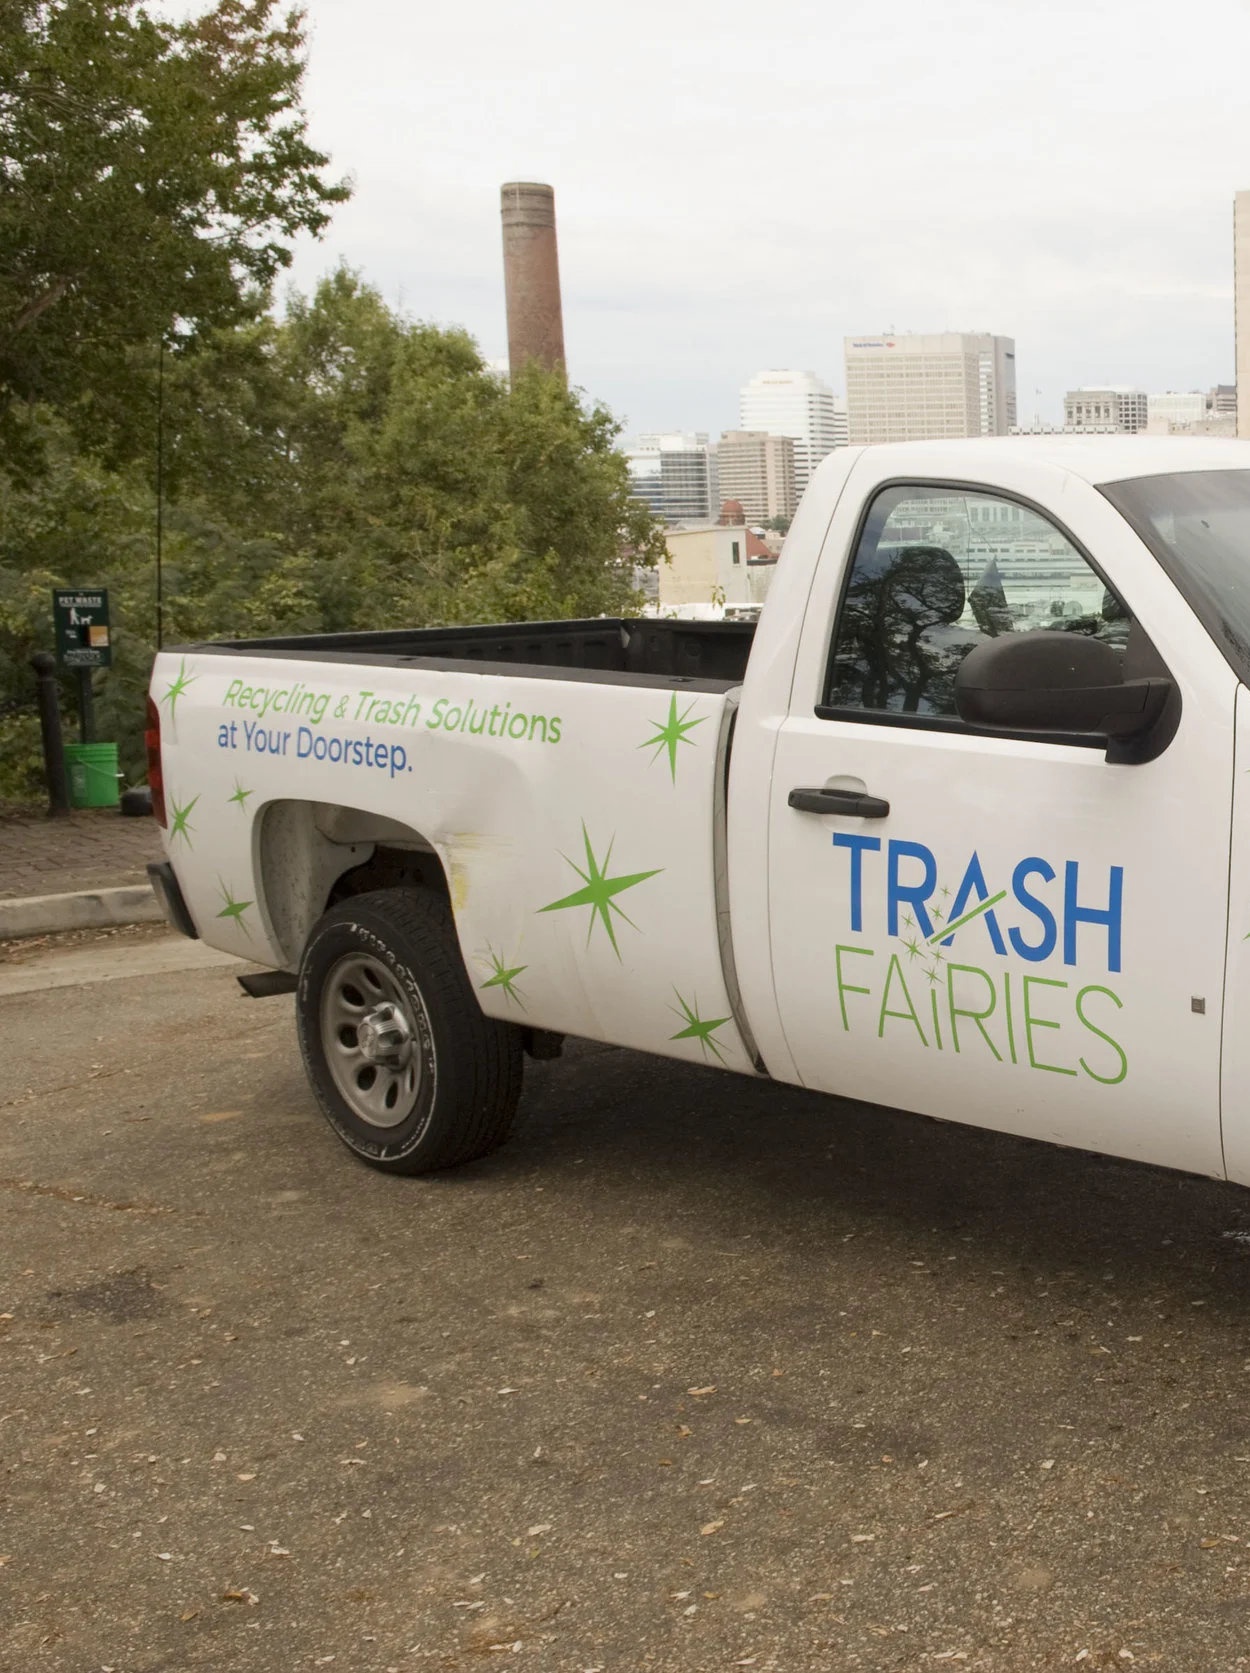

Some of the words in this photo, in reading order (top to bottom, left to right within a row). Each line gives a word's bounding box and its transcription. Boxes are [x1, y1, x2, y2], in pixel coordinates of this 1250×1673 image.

[222, 679, 330, 725] Recycling
[334, 695, 347, 719] &
[354, 690, 421, 727] Trash
[426, 699, 562, 745] Solutions
[217, 722, 237, 750] at
[242, 720, 291, 755] Your
[297, 726, 413, 778] Doorstep.
[832, 832, 1124, 973] TRASH
